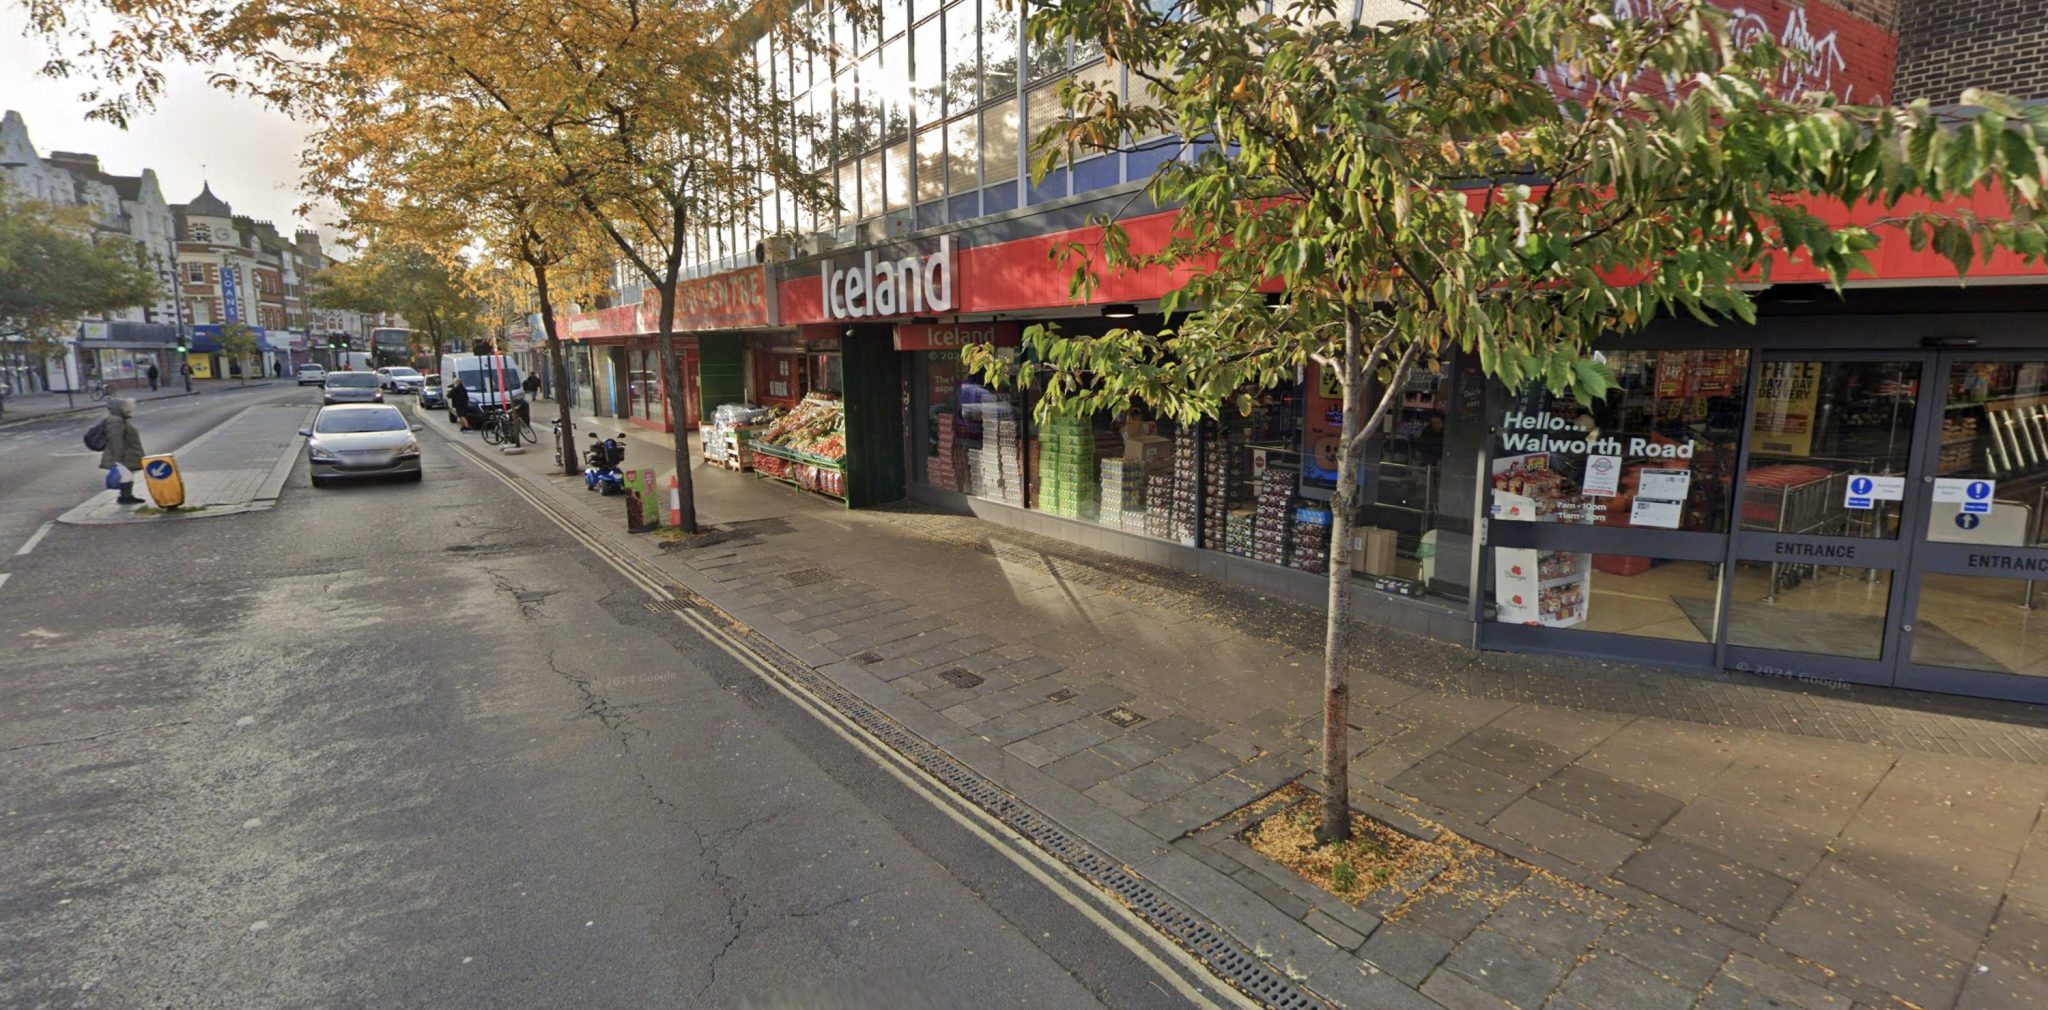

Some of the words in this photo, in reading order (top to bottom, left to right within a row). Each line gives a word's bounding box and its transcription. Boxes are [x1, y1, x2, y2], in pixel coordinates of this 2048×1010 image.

[821, 234, 952, 319] Iceland
[224, 270, 235, 315] LOANS
[927, 327, 994, 346] Iceland
[1792, 378, 1813, 388] DAY
[1758, 389, 1811, 399] DELIVERY
[1503, 411, 1587, 432] Hello...
[1503, 433, 1621, 456] Walworth
[1629, 437, 1695, 459] Road
[1775, 542, 1856, 559] ENTRANCE
